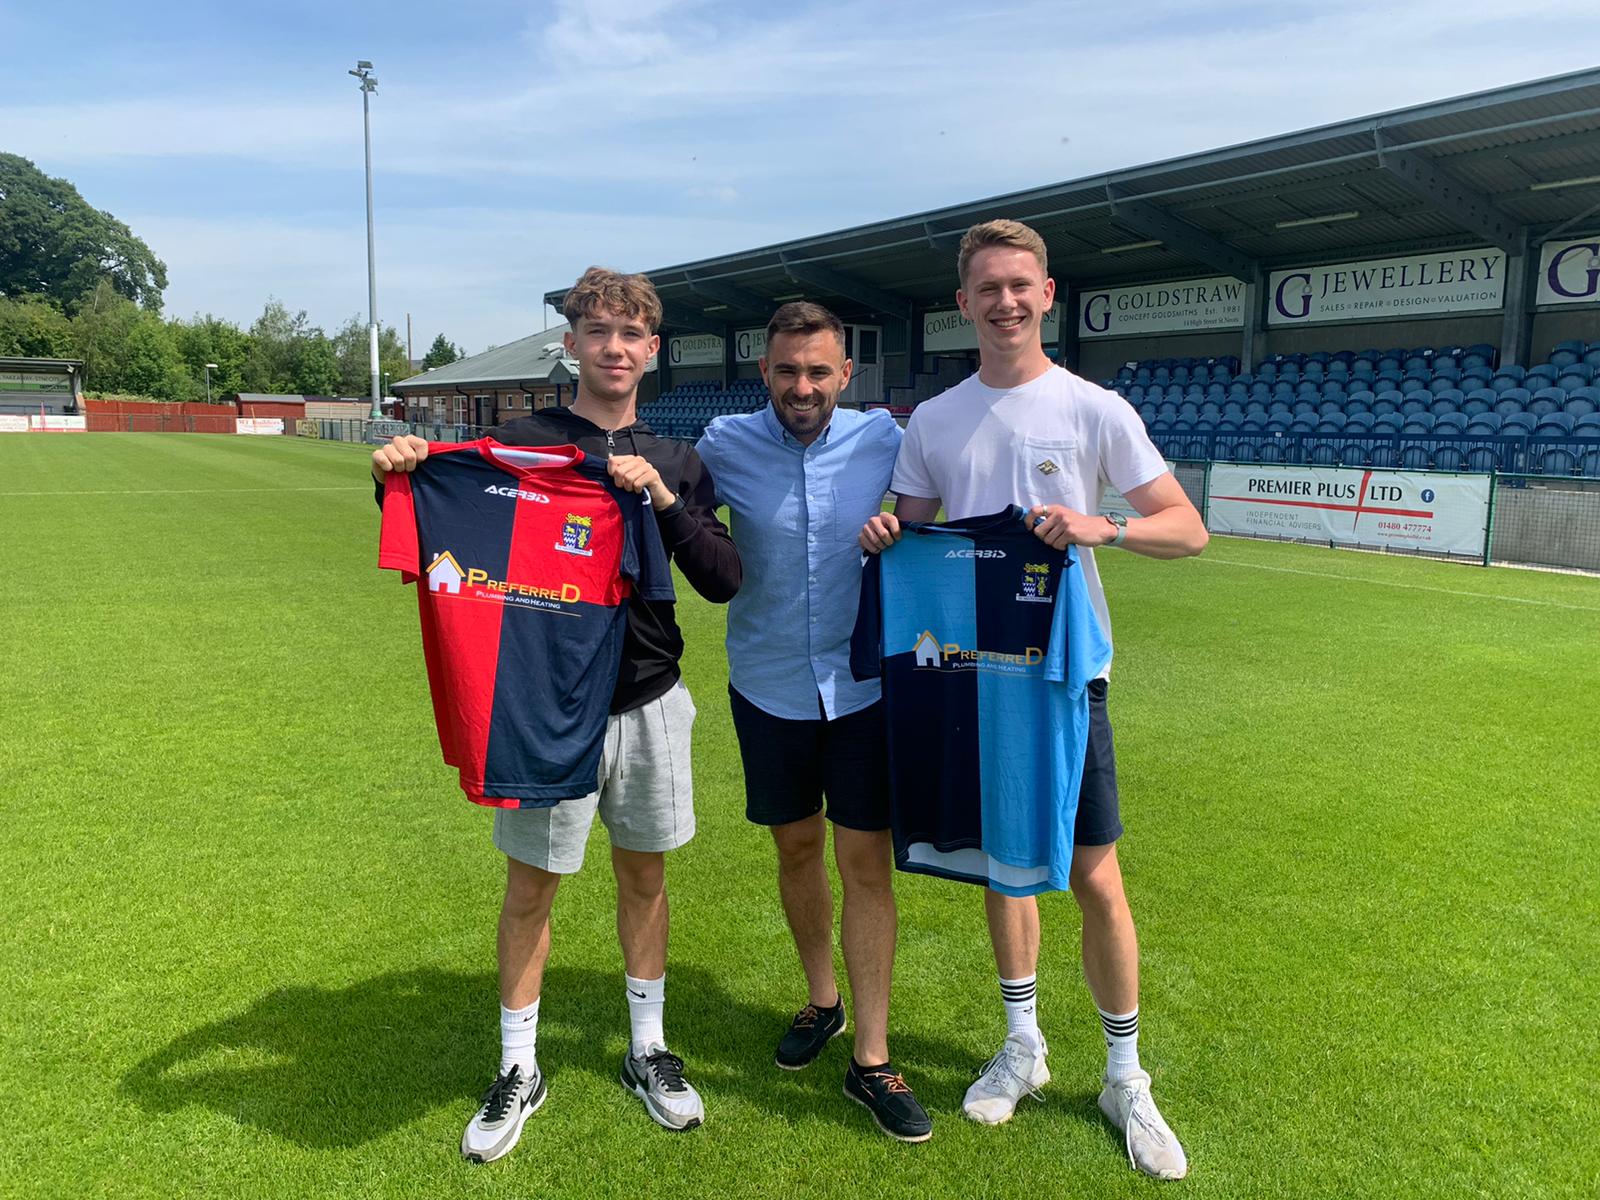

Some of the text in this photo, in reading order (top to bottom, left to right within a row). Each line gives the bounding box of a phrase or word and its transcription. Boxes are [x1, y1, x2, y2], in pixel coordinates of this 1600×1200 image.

[1321, 256, 1500, 299] JEWELLERY
[1117, 283, 1243, 310] GOLDSTRAW
[1320, 291, 1497, 312] SALES REPAIR DESIGN VALUATION
[1118, 314, 1150, 322] CONCEPT
[1152, 309, 1198, 319] GOLDSMITHS
[1222, 305, 1241, 313] 1981
[926, 314, 958, 335] COME
[1248, 479, 1402, 502] PREMIER PLUS LTD
[1246, 511, 1299, 520] INDEPENDENT
[1246, 518, 1322, 531] FINANCIAL ADVISERS
[1378, 522, 1432, 533] 01480 477774
[475, 590, 561, 609] PLUMBING AND HEATING
